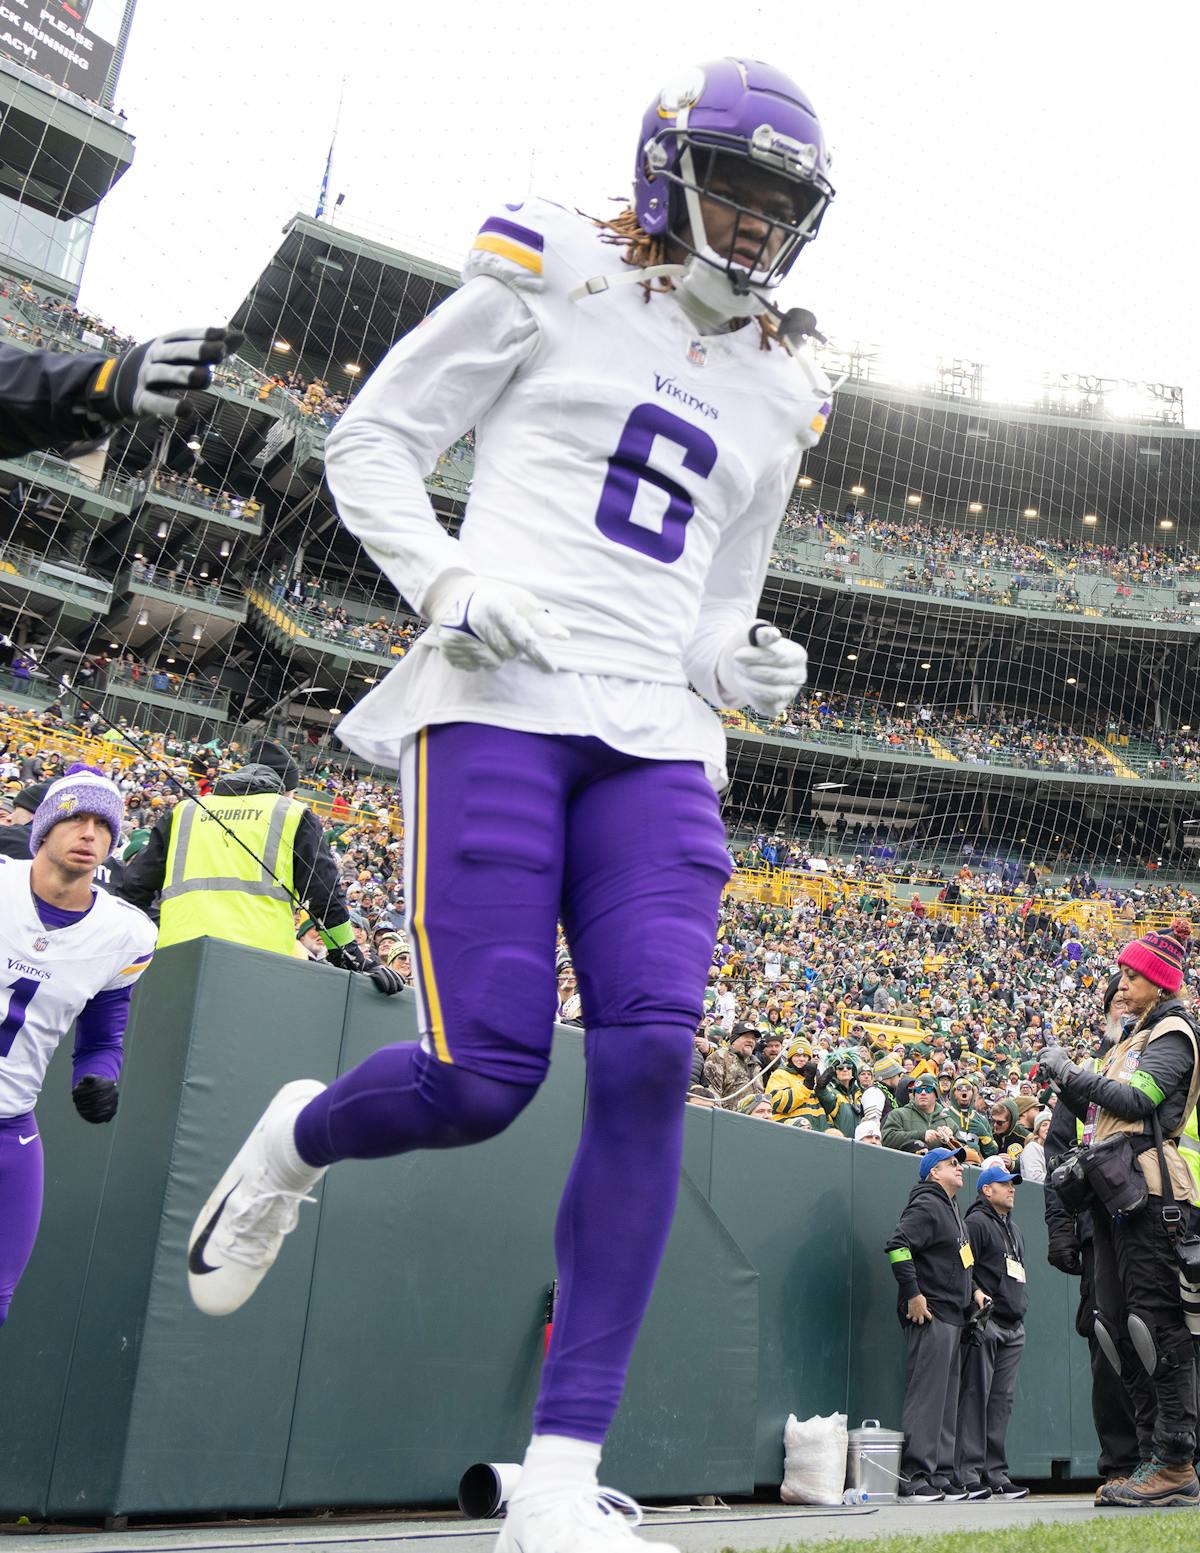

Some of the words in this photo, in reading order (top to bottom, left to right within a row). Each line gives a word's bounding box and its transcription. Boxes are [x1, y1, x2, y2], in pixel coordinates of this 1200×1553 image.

[23, 21, 89, 70] RUNNING
[40, 9, 94, 51] PLEASE
[595, 403, 718, 563] 6
[200, 808, 263, 823] SECURITY
[959, 1003, 971, 1015] 33
